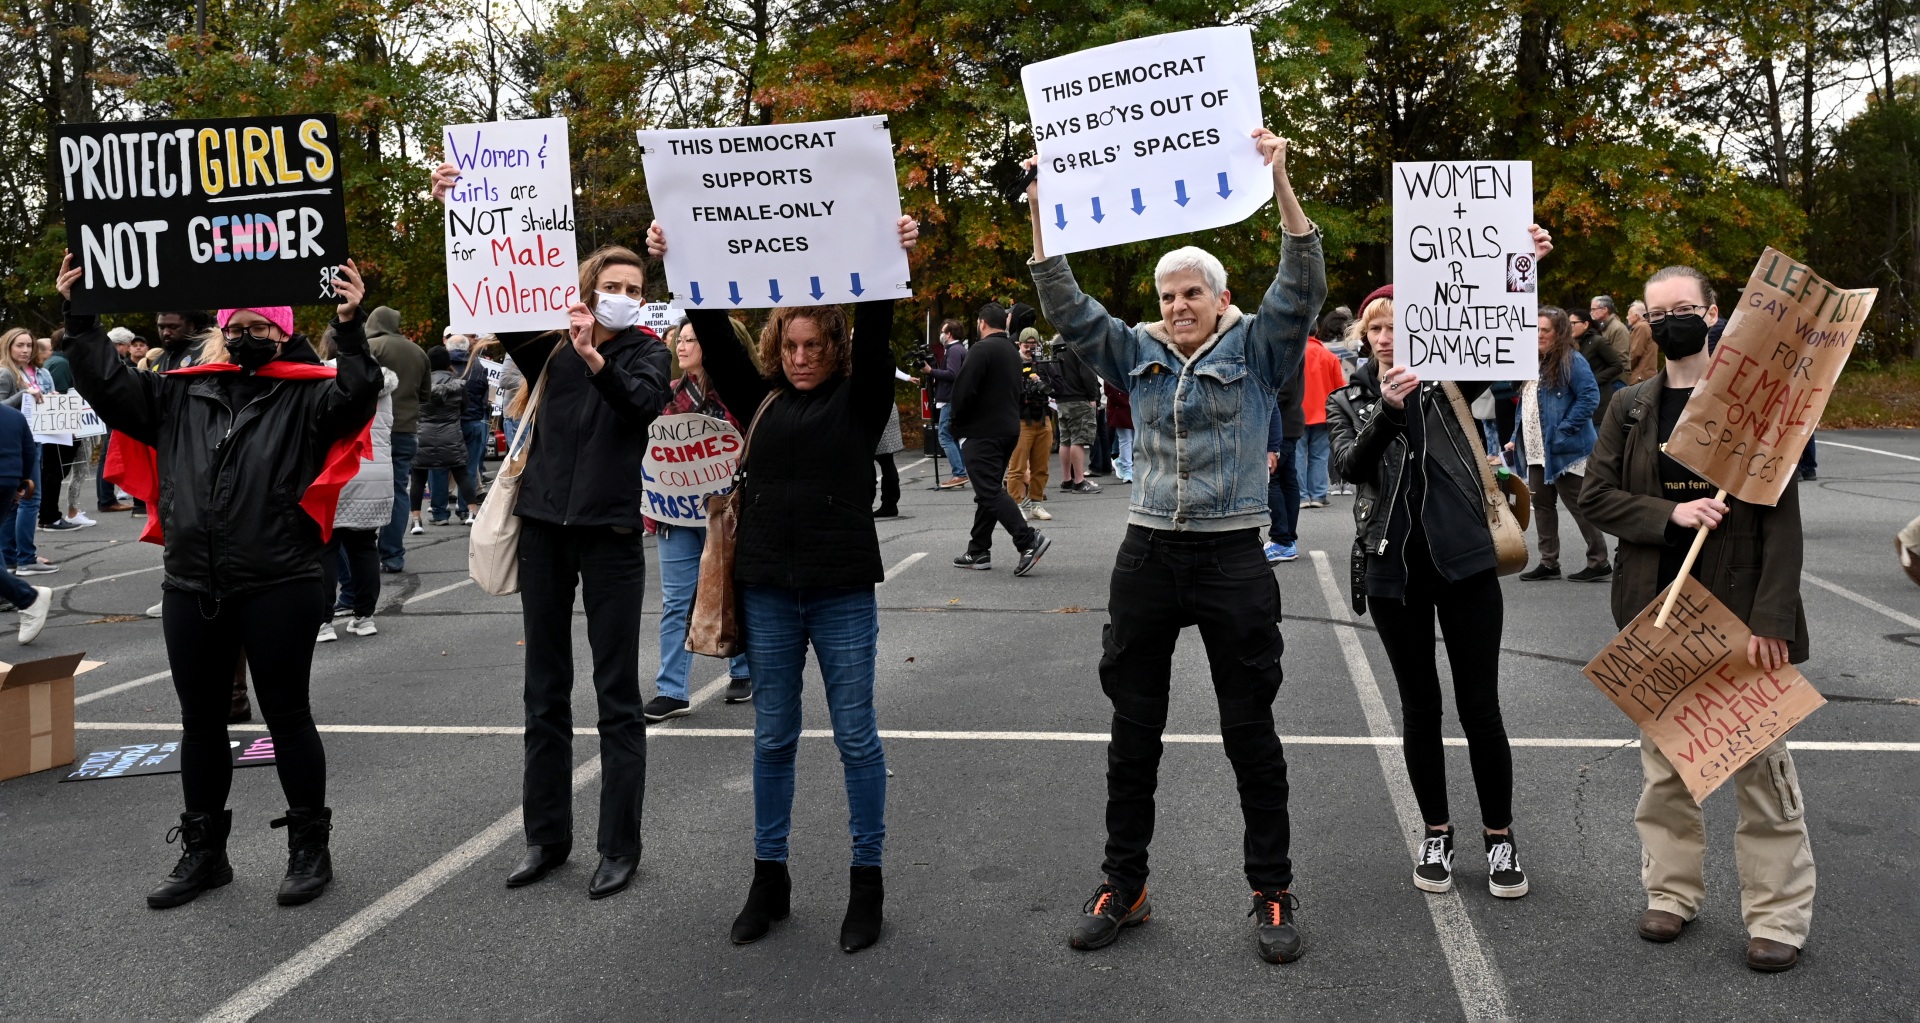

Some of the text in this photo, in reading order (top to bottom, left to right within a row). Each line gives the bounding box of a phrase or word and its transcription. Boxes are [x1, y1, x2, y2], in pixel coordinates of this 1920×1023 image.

[1042, 56, 1206, 103] THIS DEMOCRAT
[1035, 117, 1081, 142] SAYS
[1150, 94, 1194, 117] OUT
[1200, 89, 1229, 108] OF
[59, 118, 334, 201] PROTECT GIRLS
[448, 130, 530, 170] Women
[668, 131, 836, 156] THIS DEMOCRAT
[1133, 128, 1221, 157] SPACES
[451, 175, 538, 203] Girls are
[702, 168, 813, 189] SUPPORTS
[1400, 162, 1512, 200] WOMEN
[449, 206, 513, 237] NOT
[692, 200, 835, 222] FEMALE-ONLY
[81, 206, 325, 290] NOT GENDER
[452, 234, 565, 268] for Male
[727, 236, 809, 255] SPACES
[1409, 225, 1502, 263] GIRLS
[1448, 261, 1464, 283] R
[1763, 255, 1870, 323] LEFTIST
[452, 270, 576, 317] Violence
[1434, 281, 1480, 306] NOT
[1405, 303, 1537, 333] COLLATERAL
[1749, 292, 1852, 348] GAY WOMAN
[1409, 333, 1515, 368] DAMAGE
[1771, 341, 1813, 380] FOR
[1705, 345, 1822, 426] FEMALE
[32, 412, 82, 432] ZEIGLER
[1727, 403, 1789, 448] ONLY
[651, 435, 739, 463] CRIMES
[1696, 420, 1783, 483] SPACES
[660, 458, 740, 487] COLLUDE
[1591, 624, 1666, 697] NAME
[1631, 621, 1727, 714] PROBLEM:
[1673, 663, 1750, 737] MALE
[1677, 671, 1791, 763] VIOLENCE
[1726, 723, 1751, 745] IN
